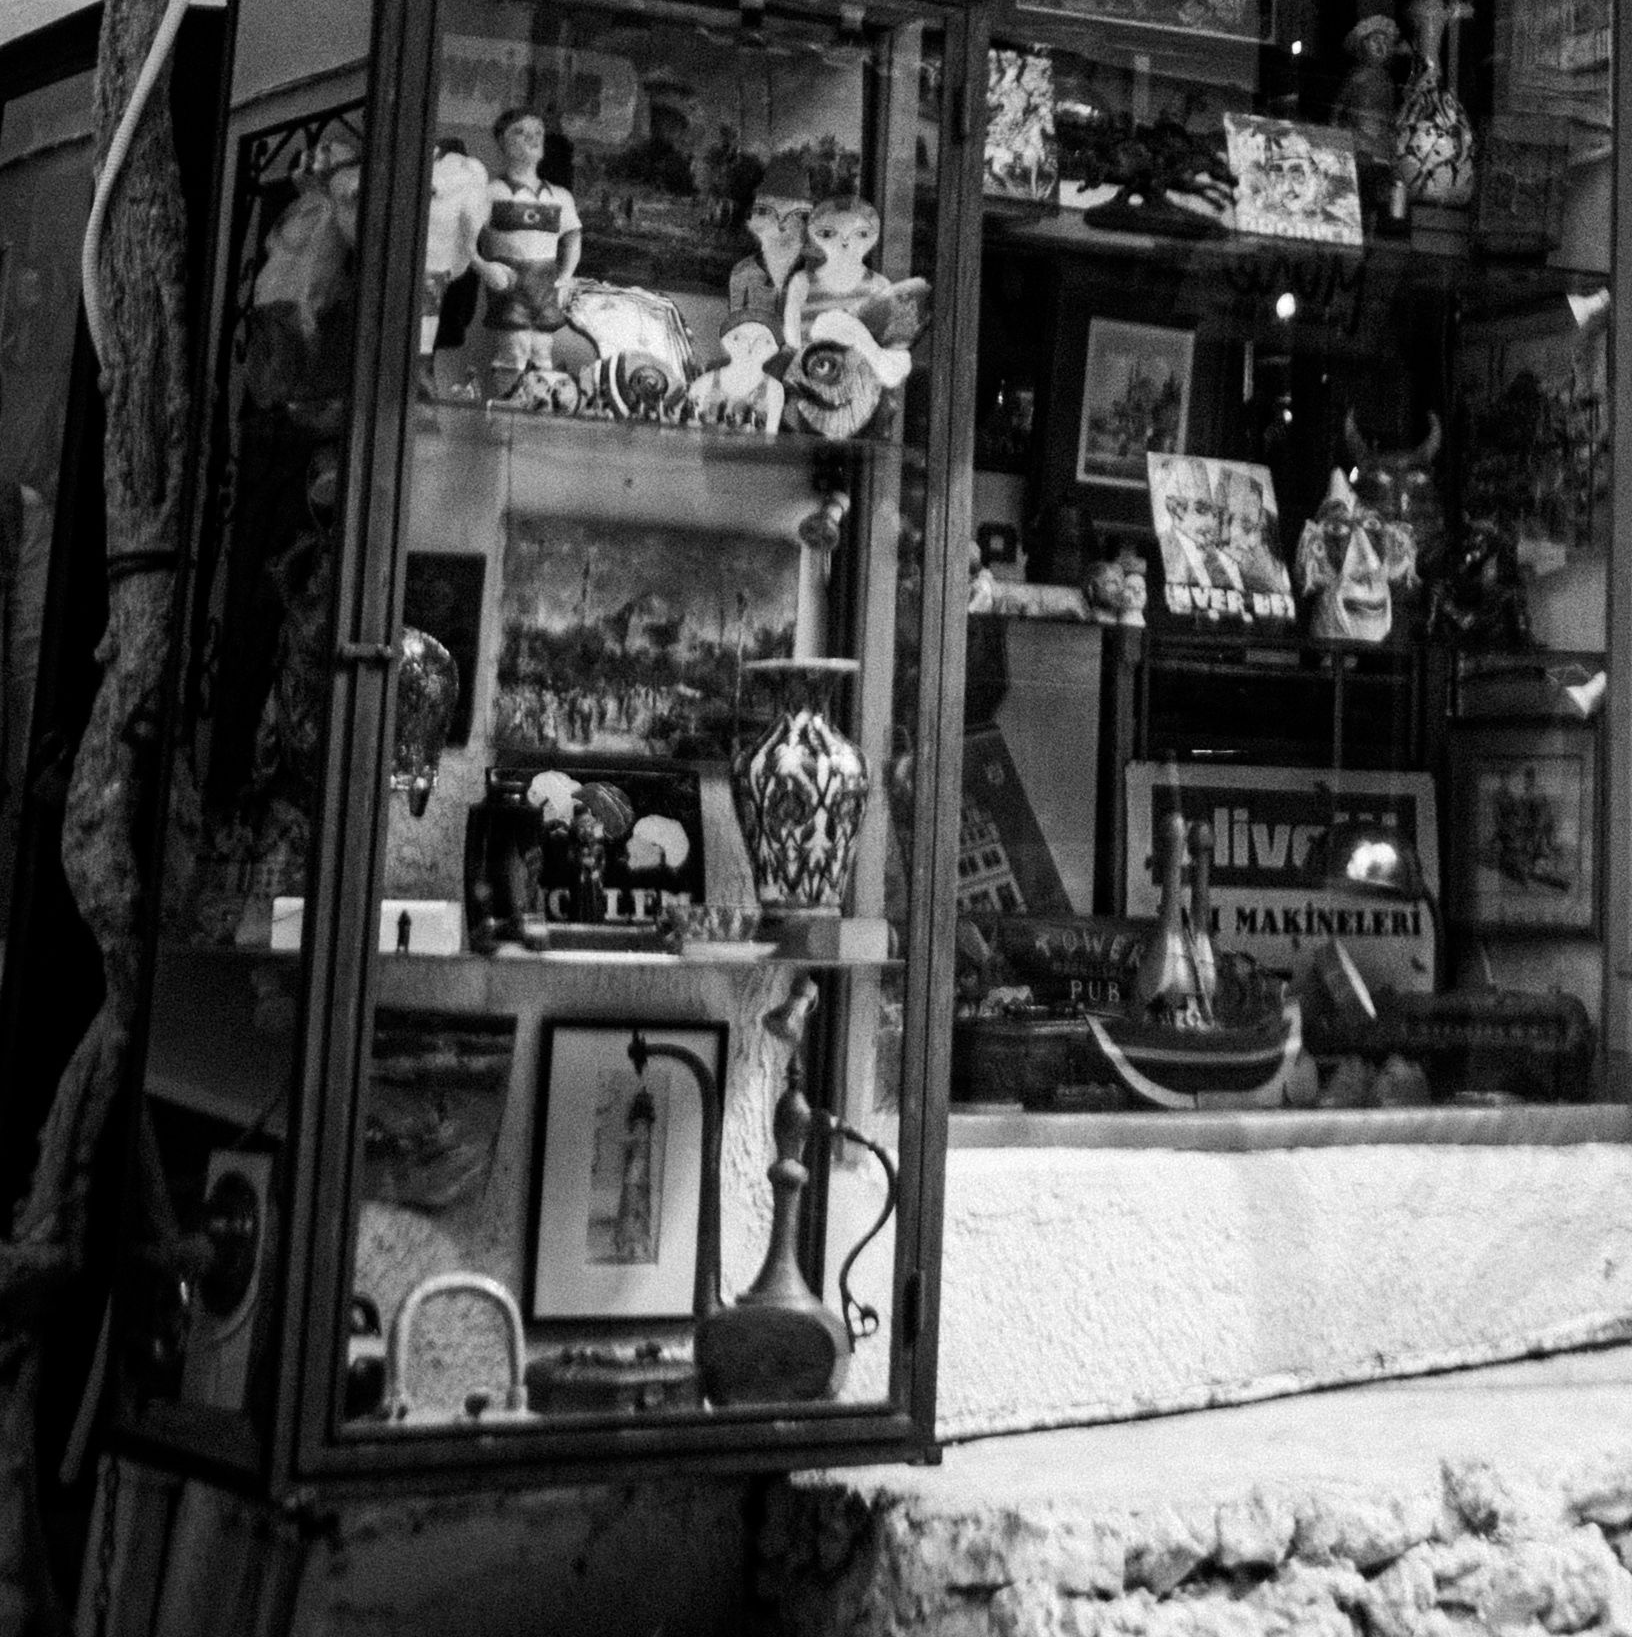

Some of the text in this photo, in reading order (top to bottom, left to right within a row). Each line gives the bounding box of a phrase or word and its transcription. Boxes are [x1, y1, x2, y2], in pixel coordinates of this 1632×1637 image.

[1235, 901, 1422, 936] MAKİNELERİ
[1034, 928, 1146, 969] TOWER
[1069, 978, 1121, 1004] PUB
